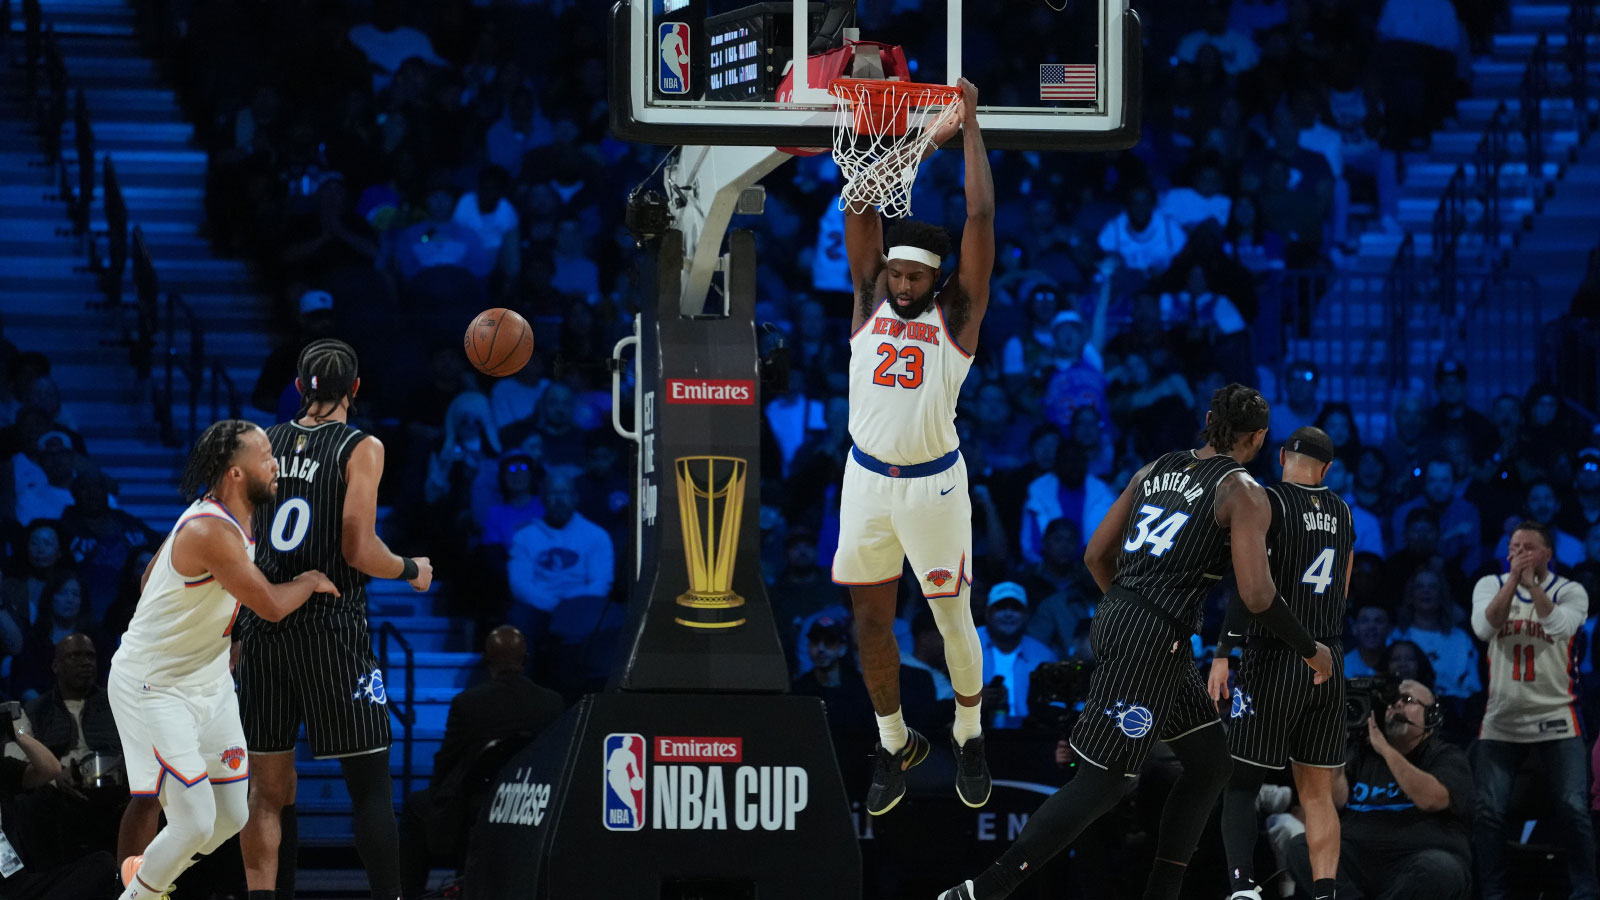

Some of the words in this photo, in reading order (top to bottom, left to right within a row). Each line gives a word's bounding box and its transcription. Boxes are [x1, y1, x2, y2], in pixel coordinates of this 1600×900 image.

[663, 77, 679, 89] NBA
[872, 317, 906, 338] NEW
[873, 341, 925, 389] 23
[671, 382, 749, 400] Emirates
[1143, 471, 1191, 497] CARTER
[1183, 482, 1204, 506] JR.
[269, 495, 313, 553] 0
[1124, 503, 1192, 557] 34
[1302, 510, 1338, 535] SUGGS
[1301, 547, 1336, 596] 4
[1512, 643, 1536, 682] 11
[659, 739, 738, 758] Emirates
[489, 766, 551, 827] coinbase
[652, 765, 728, 830] NBA
[735, 765, 809, 831] CUP
[609, 808, 630, 824] NBA
